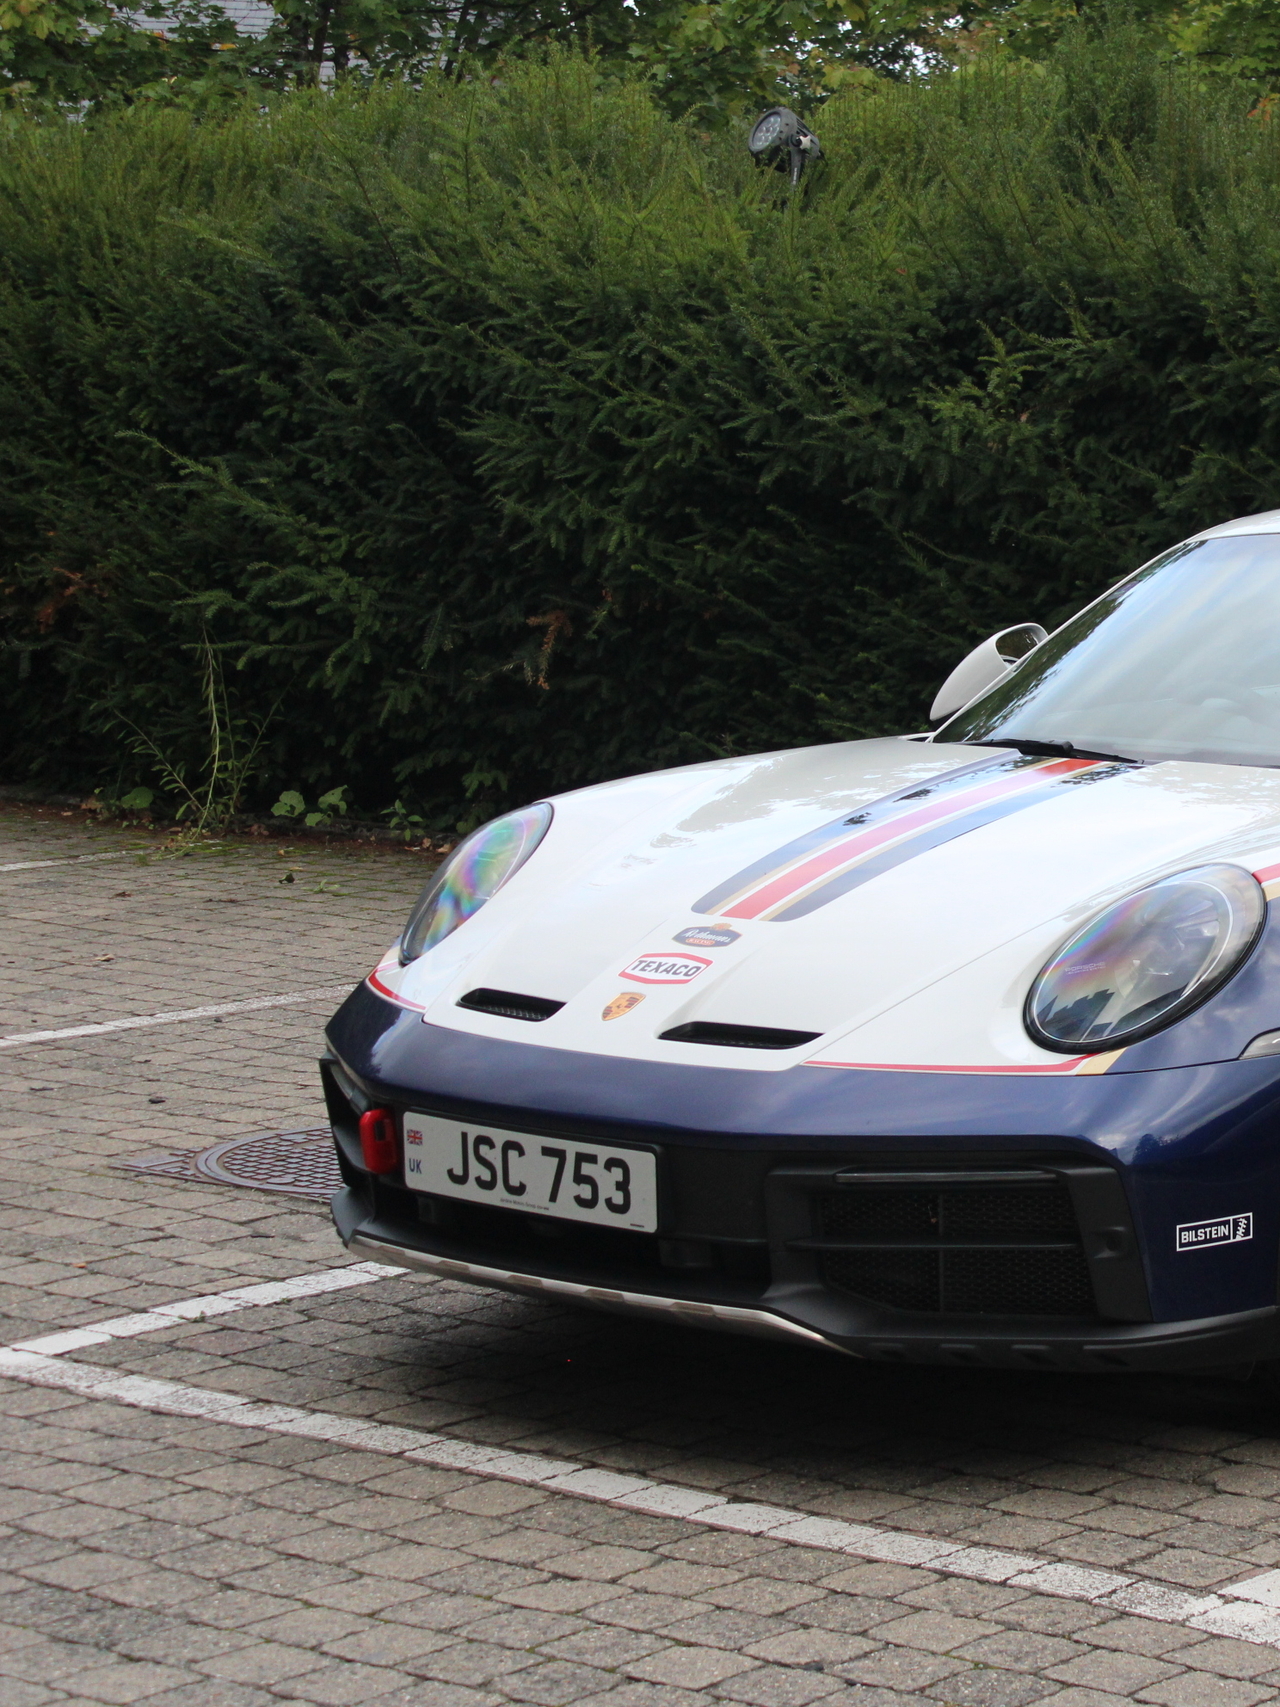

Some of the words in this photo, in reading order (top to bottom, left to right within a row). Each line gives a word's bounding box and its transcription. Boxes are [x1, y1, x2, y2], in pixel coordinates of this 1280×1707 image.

[630, 959, 702, 977] TEXACO
[408, 1158, 422, 1174] UK
[447, 1131, 527, 1197] JSC
[540, 1145, 632, 1215] 753
[1181, 1224, 1229, 1244] BILSTEIN
